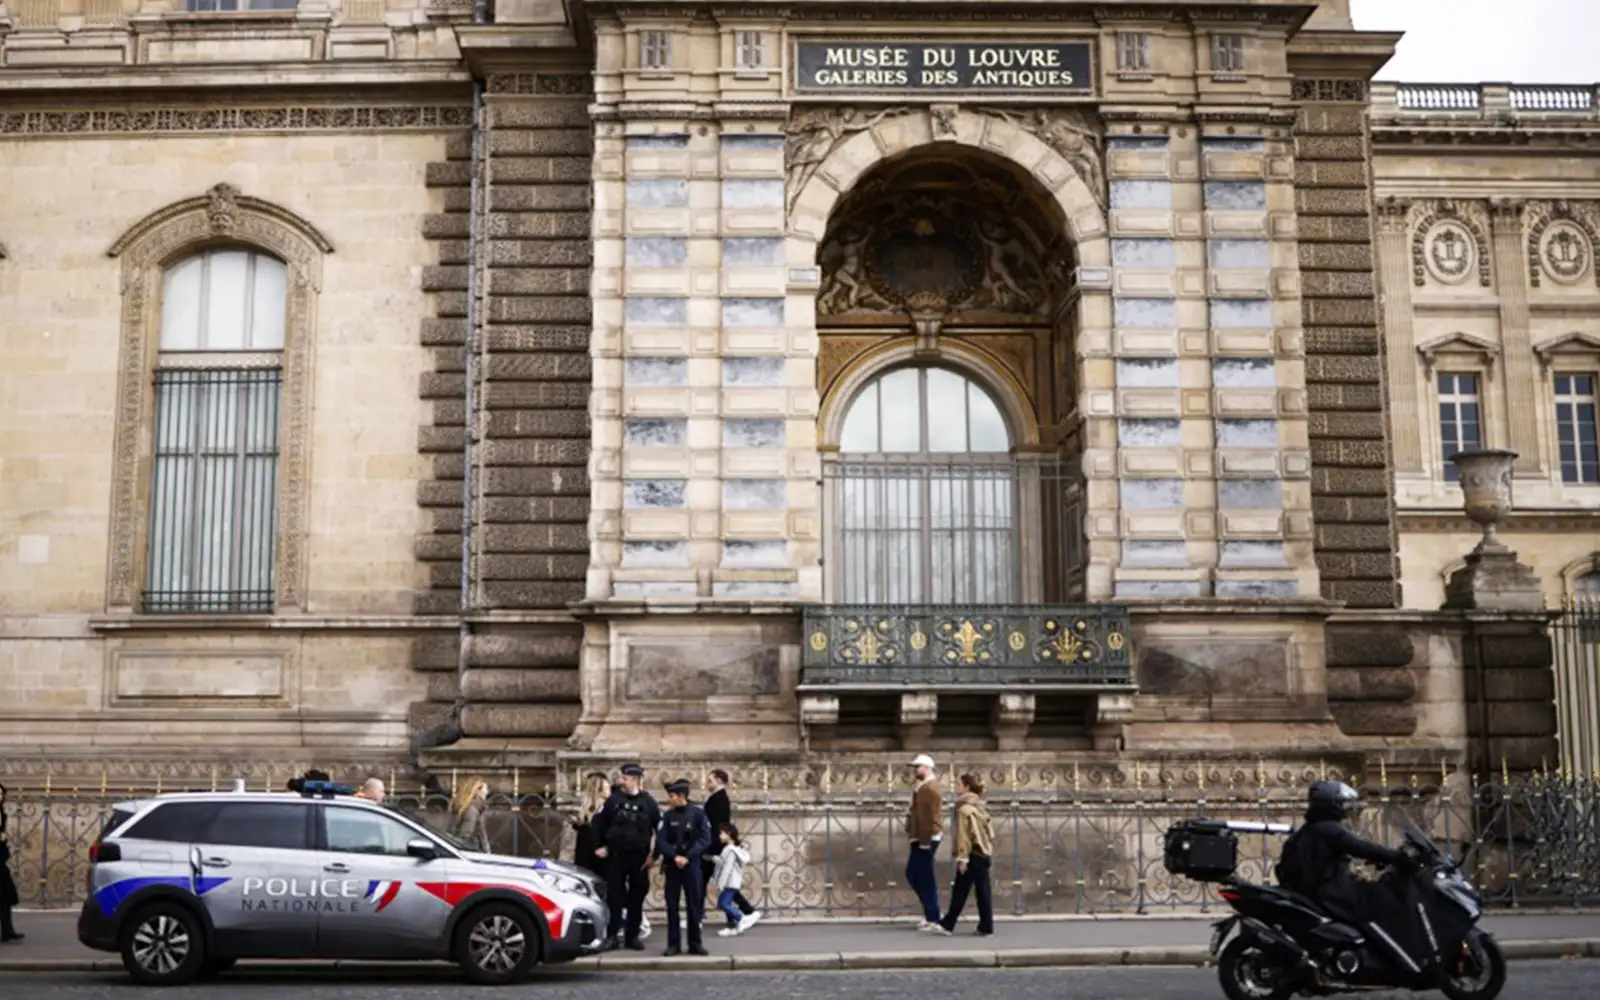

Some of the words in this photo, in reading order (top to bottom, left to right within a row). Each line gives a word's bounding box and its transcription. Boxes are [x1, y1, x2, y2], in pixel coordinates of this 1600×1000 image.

[825, 47, 908, 66] MUSÉE
[923, 49, 956, 67] DU
[969, 49, 1061, 67] LOUVRE
[815, 70, 908, 85] GALERIES
[921, 70, 958, 85] DES
[972, 70, 1073, 87] ANTIQUES
[243, 878, 359, 898] POLICE
[242, 900, 359, 912] NATIONALE
